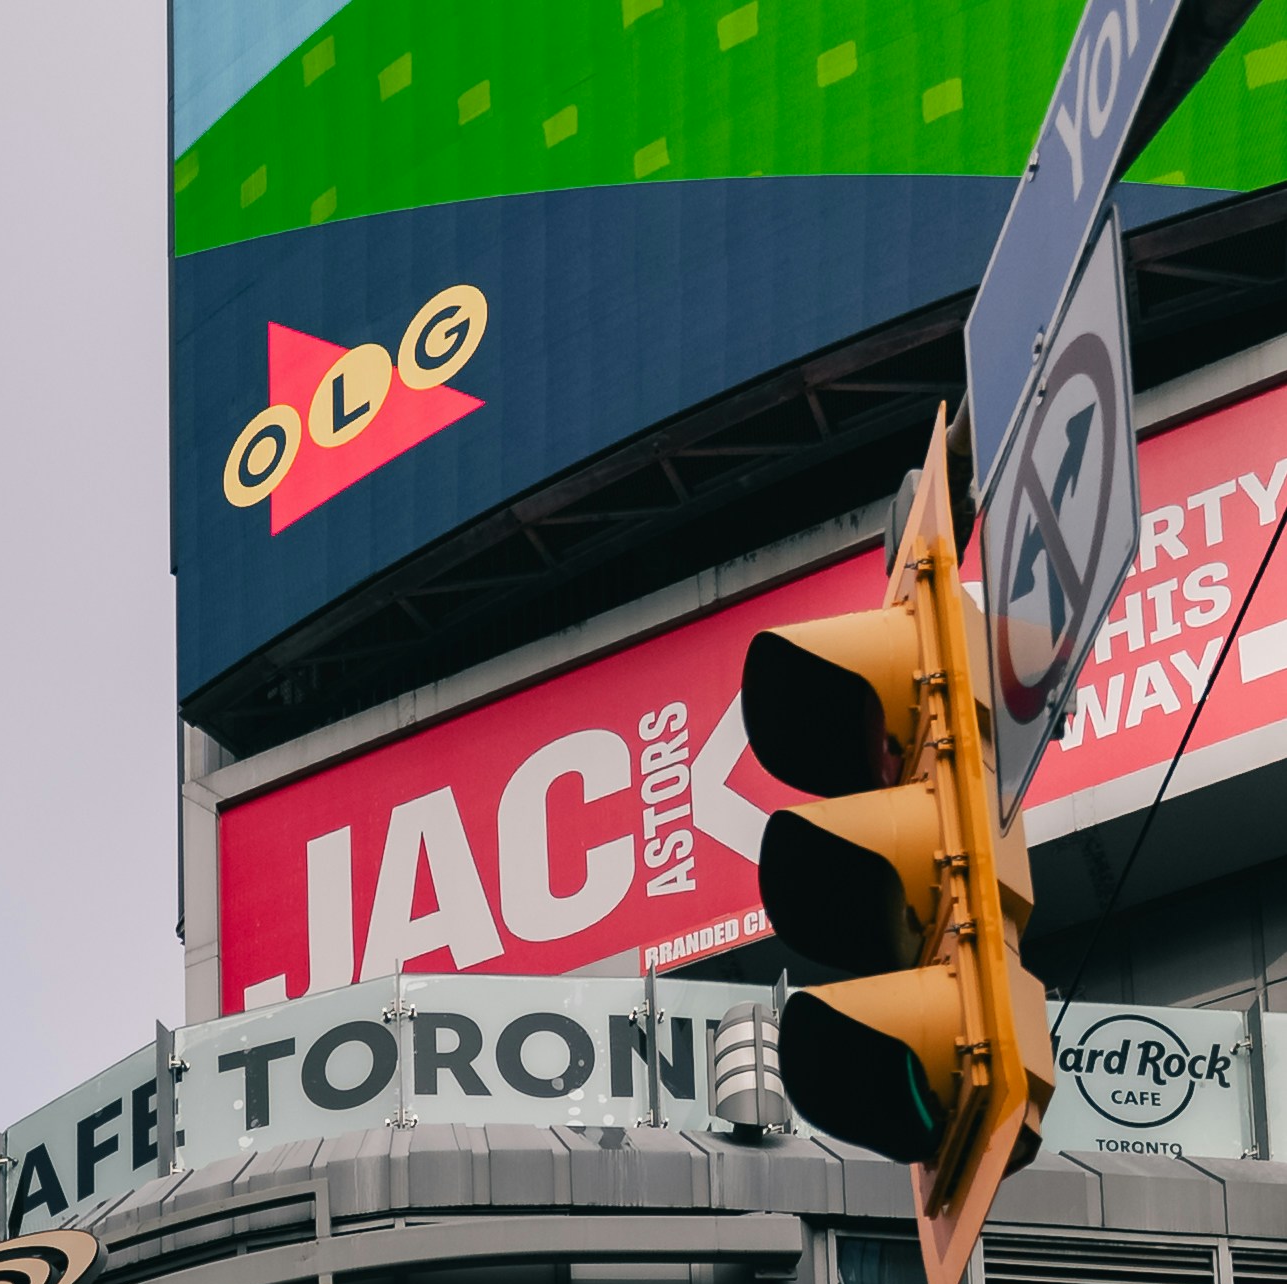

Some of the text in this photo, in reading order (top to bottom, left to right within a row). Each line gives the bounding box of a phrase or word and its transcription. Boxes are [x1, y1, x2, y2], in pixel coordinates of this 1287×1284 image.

[1055, 0, 1154, 202] YO
[230, 294, 480, 500] OLG
[1126, 458, 1287, 579] RTY
[1094, 562, 1231, 664] HIS
[639, 701, 697, 897] ASTORS
[645, 908, 773, 970] BRANDED CI
[218, 1011, 716, 1129] TORON
[1053, 1035, 1231, 1088] ard Rock
[1110, 1090, 1162, 1107] CAFE
[1096, 1138, 1183, 1155] TORONTO
